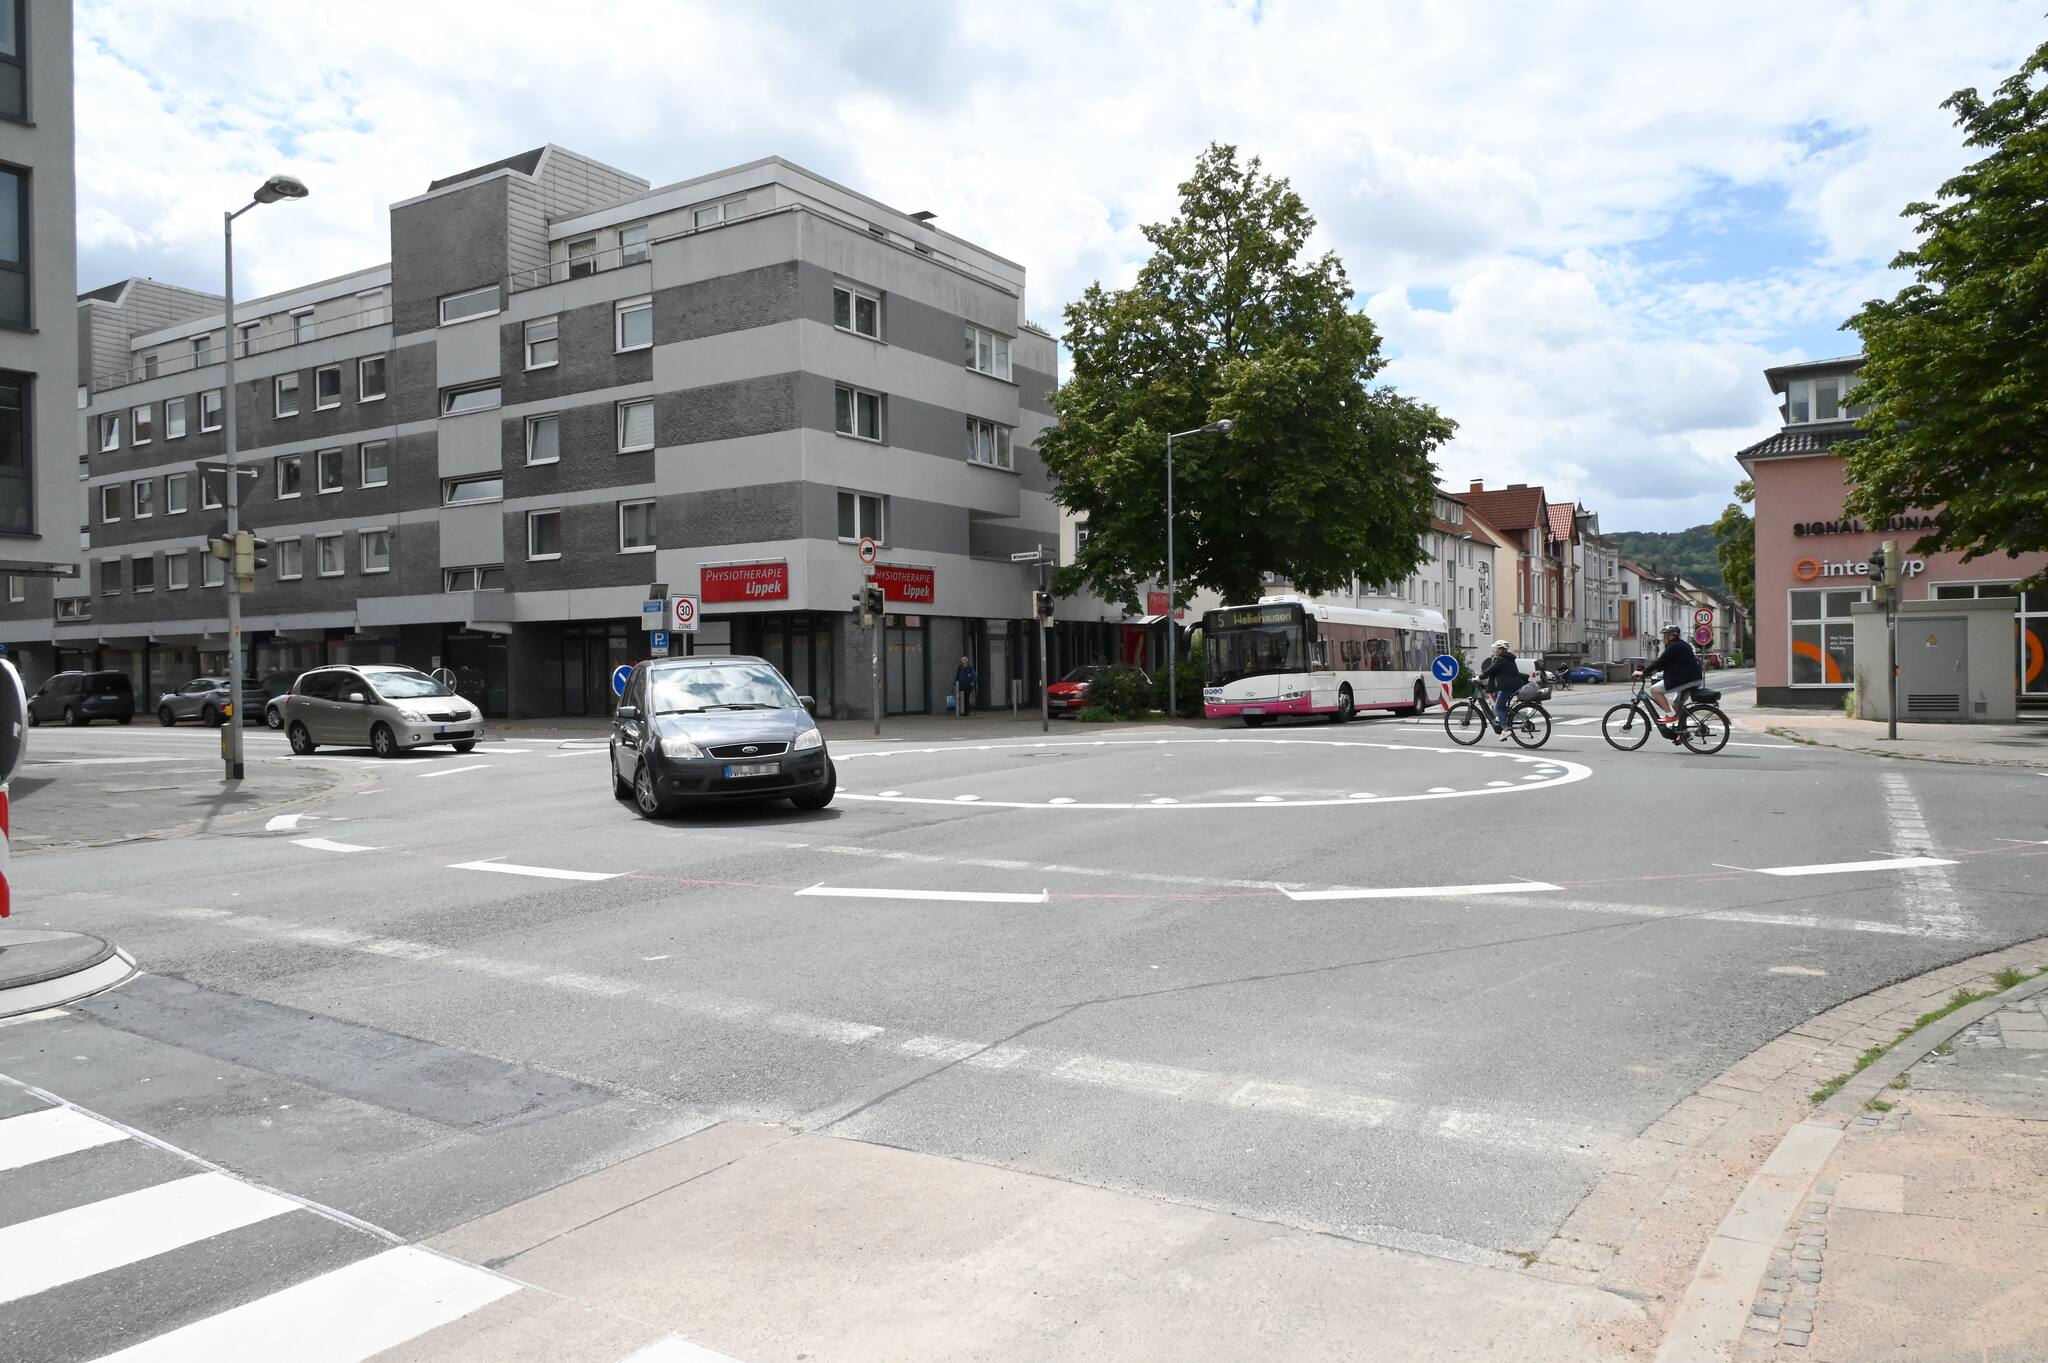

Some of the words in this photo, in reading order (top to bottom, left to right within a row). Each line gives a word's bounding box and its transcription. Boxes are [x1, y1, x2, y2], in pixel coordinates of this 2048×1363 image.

[1793, 520, 1863, 537] SIGNAL
[1879, 516, 1933, 530] UNA
[706, 568, 783, 582] PHYSIOTHERAPIE
[872, 570, 931, 583] HYSIOTHERAPIE
[746, 580, 782, 597] Lippek
[903, 583, 930, 599] Lippek
[679, 605, 691, 616] 30
[1698, 613, 1710, 622] 30
[1217, 614, 1224, 628] 5
[655, 632, 664, 646] P
